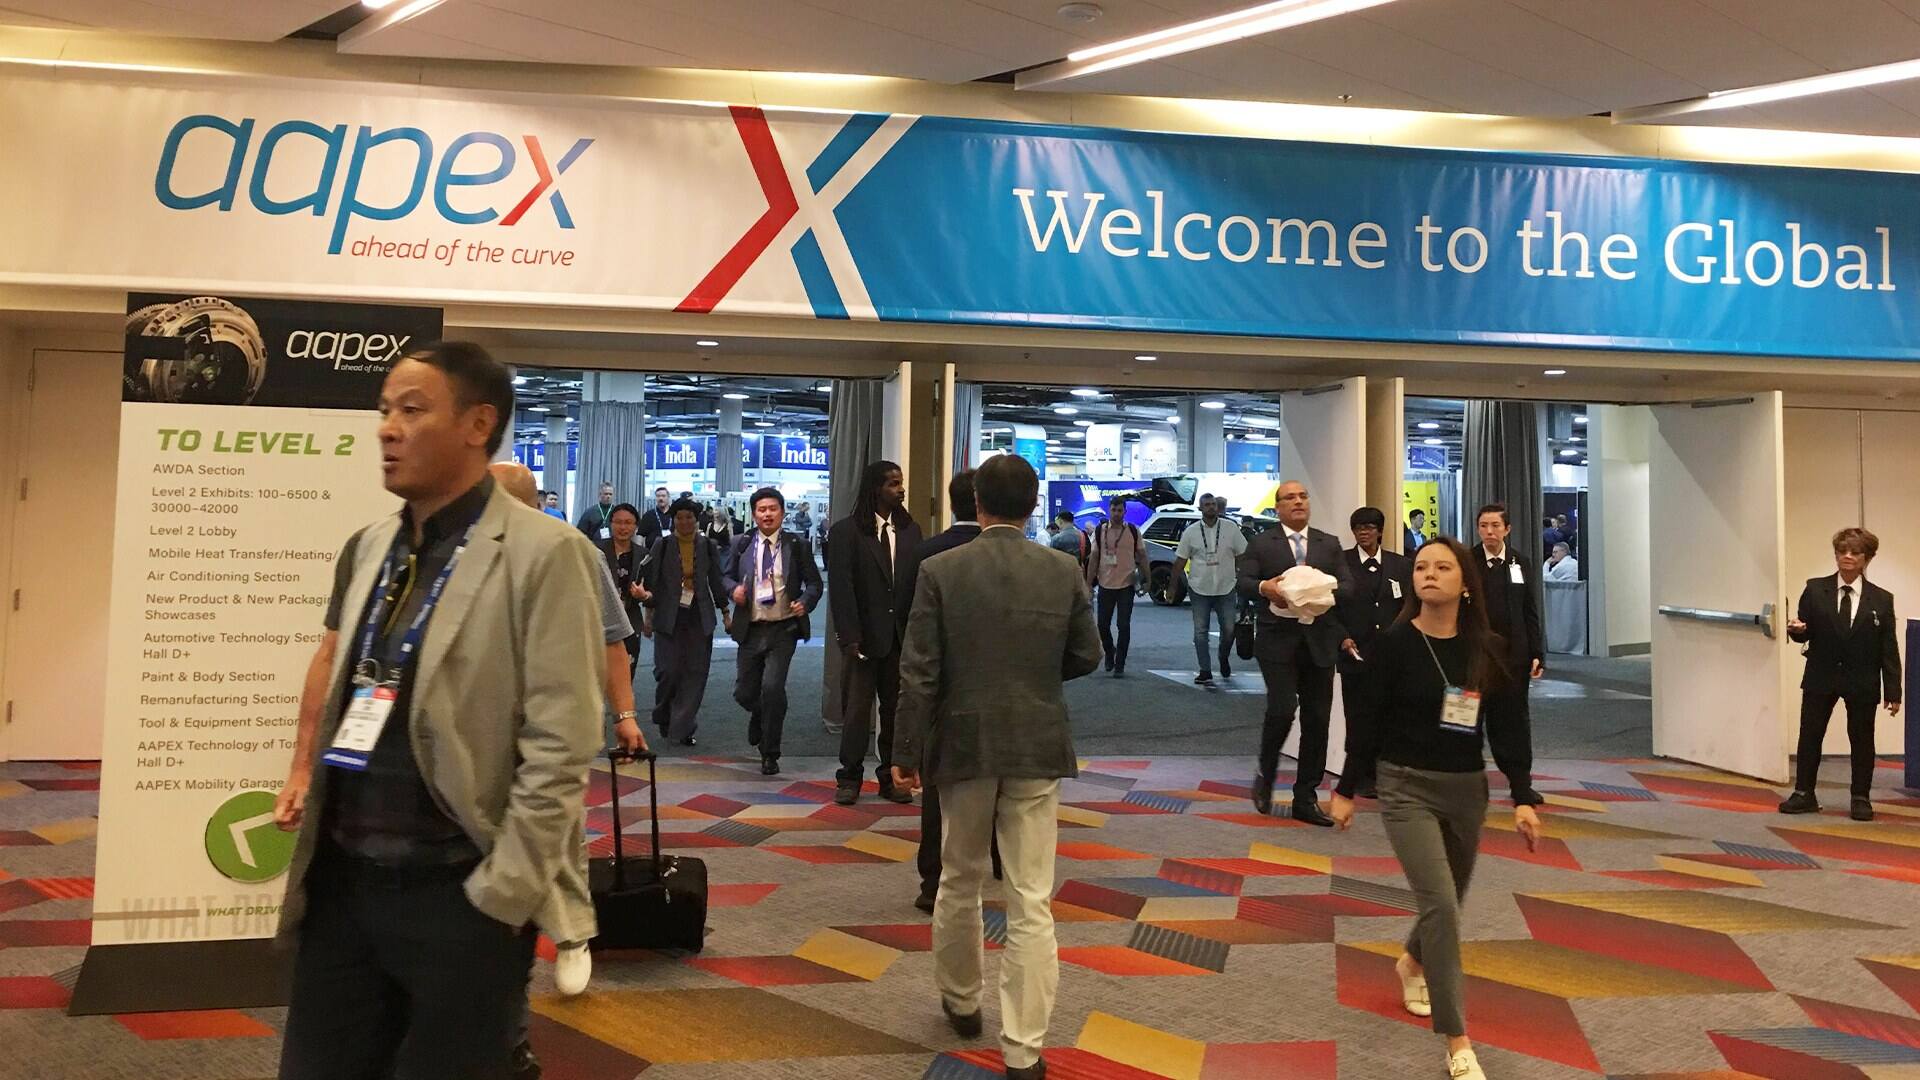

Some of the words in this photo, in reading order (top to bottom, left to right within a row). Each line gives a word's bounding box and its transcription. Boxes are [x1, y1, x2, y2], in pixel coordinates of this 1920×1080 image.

[155, 114, 596, 255] aapex
[1012, 188, 1388, 269] Welcome
[1415, 214, 1488, 273] to
[1516, 210, 1638, 281] the
[1664, 218, 1897, 291] Global
[351, 235, 429, 260] ahead
[434, 238, 461, 266] of
[466, 240, 504, 263] the
[511, 247, 575, 266] curve
[286, 330, 411, 370] aapex
[157, 428, 203, 452] TO
[212, 430, 322, 455] LEVEL
[334, 434, 355, 456] 2
[665, 444, 697, 464] India
[780, 441, 827, 465] India
[153, 463, 194, 475] AWDA
[198, 465, 245, 476] Section
[152, 487, 185, 497] Level
[188, 487, 197, 498] 2
[201, 487, 253, 498] Exhibits:
[321, 490, 331, 500] &
[150, 525, 182, 536] Level
[186, 526, 195, 536] 2
[199, 526, 237, 539] Lobby
[148, 548, 191, 559] Mobile
[195, 549, 225, 559] Heat
[229, 549, 337, 562] Transfer/Heating/
[146, 571, 165, 581] Air
[169, 571, 249, 584] Conditioning
[253, 572, 300, 582] Section
[145, 594, 174, 604] New
[179, 594, 228, 604] Product
[232, 595, 241, 604] &
[247, 594, 274, 604] New
[145, 609, 216, 620] Showcases
[143, 632, 215, 643] Automotive
[220, 633, 290, 645] Technology
[143, 649, 167, 659] Hall
[172, 649, 190, 659] D+
[142, 672, 174, 682] Paint
[178, 672, 187, 682] &
[193, 672, 224, 684] Body
[229, 672, 275, 682] Section
[140, 694, 248, 706] Remanufacturing
[252, 694, 298, 704] Section
[139, 718, 165, 728] Tool
[169, 718, 179, 728] &
[184, 717, 251, 730] Equipment
[137, 740, 183, 751] AAPEX
[187, 739, 258, 752] Technology
[262, 738, 274, 749] of
[137, 757, 161, 767] Hall
[166, 757, 184, 767] D+
[135, 780, 181, 790] AAPEX
[185, 779, 235, 791] Mobility
[239, 778, 284, 791] Garage
[207, 906, 243, 917] WHAT
